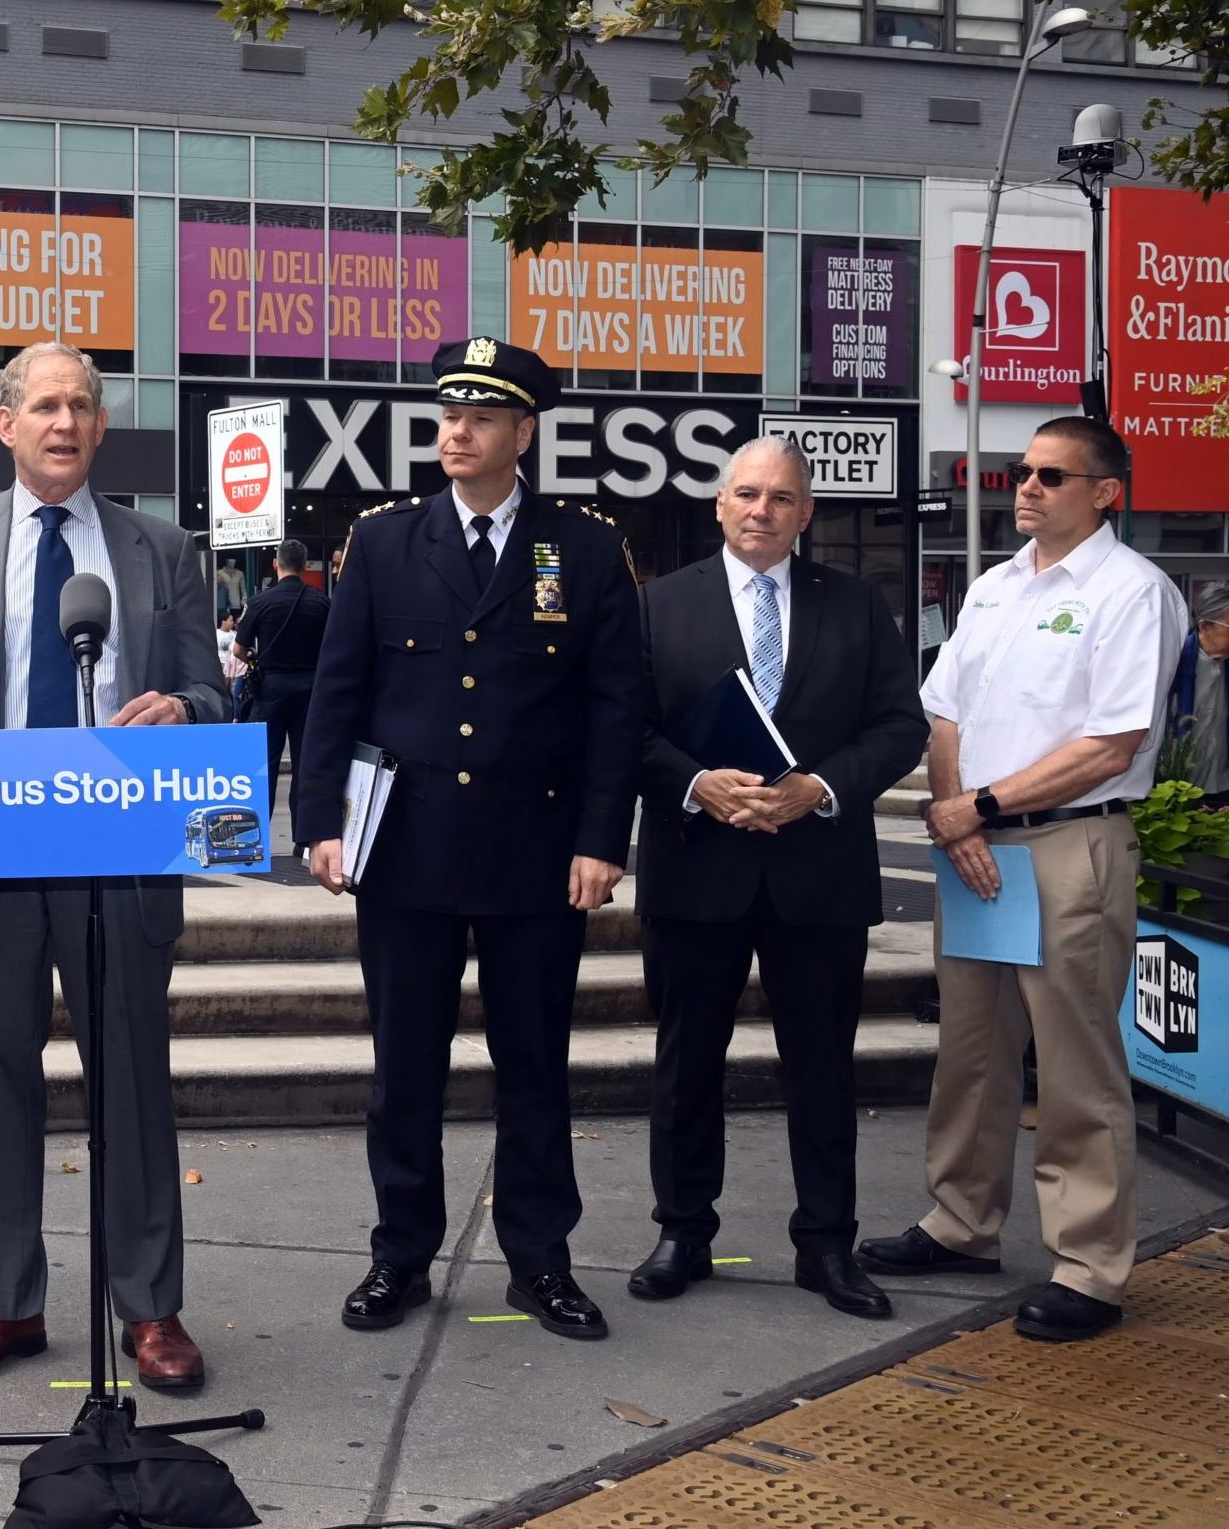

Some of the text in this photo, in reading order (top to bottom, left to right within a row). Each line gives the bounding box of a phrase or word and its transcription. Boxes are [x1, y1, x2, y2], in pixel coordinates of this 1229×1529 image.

[41, 230, 103, 276] FOR
[828, 256, 893, 272] FREE NEXT-DAY
[1137, 242, 1229, 292] Raym
[210, 246, 439, 291] NOW DELIVERING IN
[528, 258, 746, 305] NOW DELIVERING
[828, 270, 893, 291] MATTRESS
[208, 289, 441, 340] 2 DAYS OR LESS
[828, 290, 893, 311] DELIVERY
[529, 308, 746, 357] 7 DAYS A WEEK
[832, 324, 887, 344] CUSTOM
[832, 344, 886, 360] FINANCING
[832, 360, 886, 379] OPTIONS
[213, 411, 277, 434] FULTON MALL
[1124, 416, 1229, 438] MATTRE
[228, 397, 736, 499] XPESS
[229, 446, 263, 464] DO NOT
[231, 483, 262, 499] ENTER
[918, 502, 947, 512] EXPRESS
[224, 521, 244, 530] EXCEPT
[245, 519, 263, 529] BUSES
[53, 770, 145, 810] Stop
[153, 767, 252, 802] Hubs
[1139, 954, 1161, 987] DWN
[1170, 960, 1196, 999] BRK
[1138, 988, 1161, 1028] TWN
[1170, 1001, 1196, 1035] LYN
